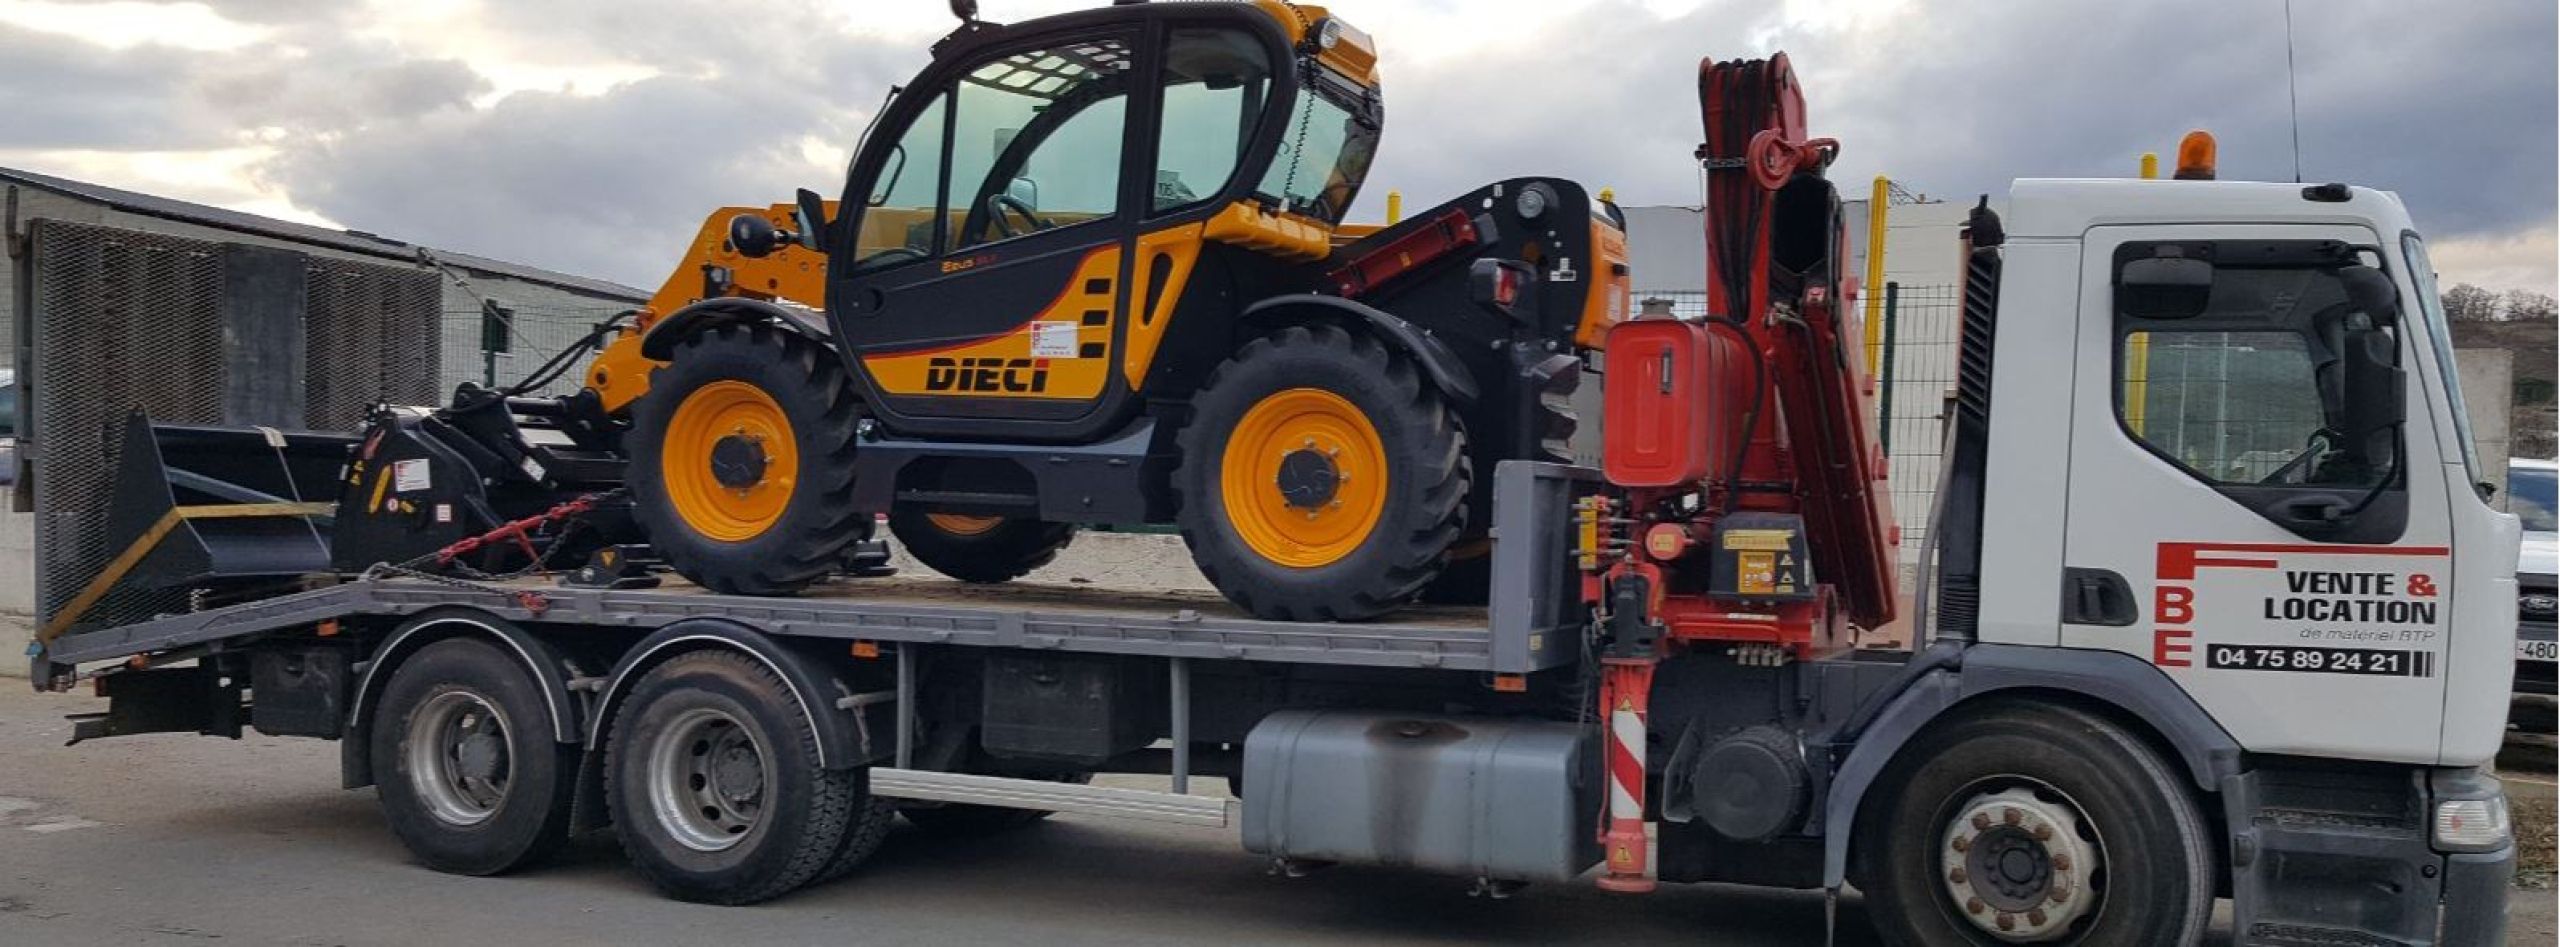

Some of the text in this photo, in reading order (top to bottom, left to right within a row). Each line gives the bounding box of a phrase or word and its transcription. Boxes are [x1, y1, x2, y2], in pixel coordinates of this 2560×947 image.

[2286, 571, 2437, 597] VENTE &
[2264, 597, 2436, 624] LOCATION
[2299, 628, 2321, 640] de
[2399, 630, 2436, 642] BTP
[2216, 648, 2399, 672] 04 75 89 24 21
